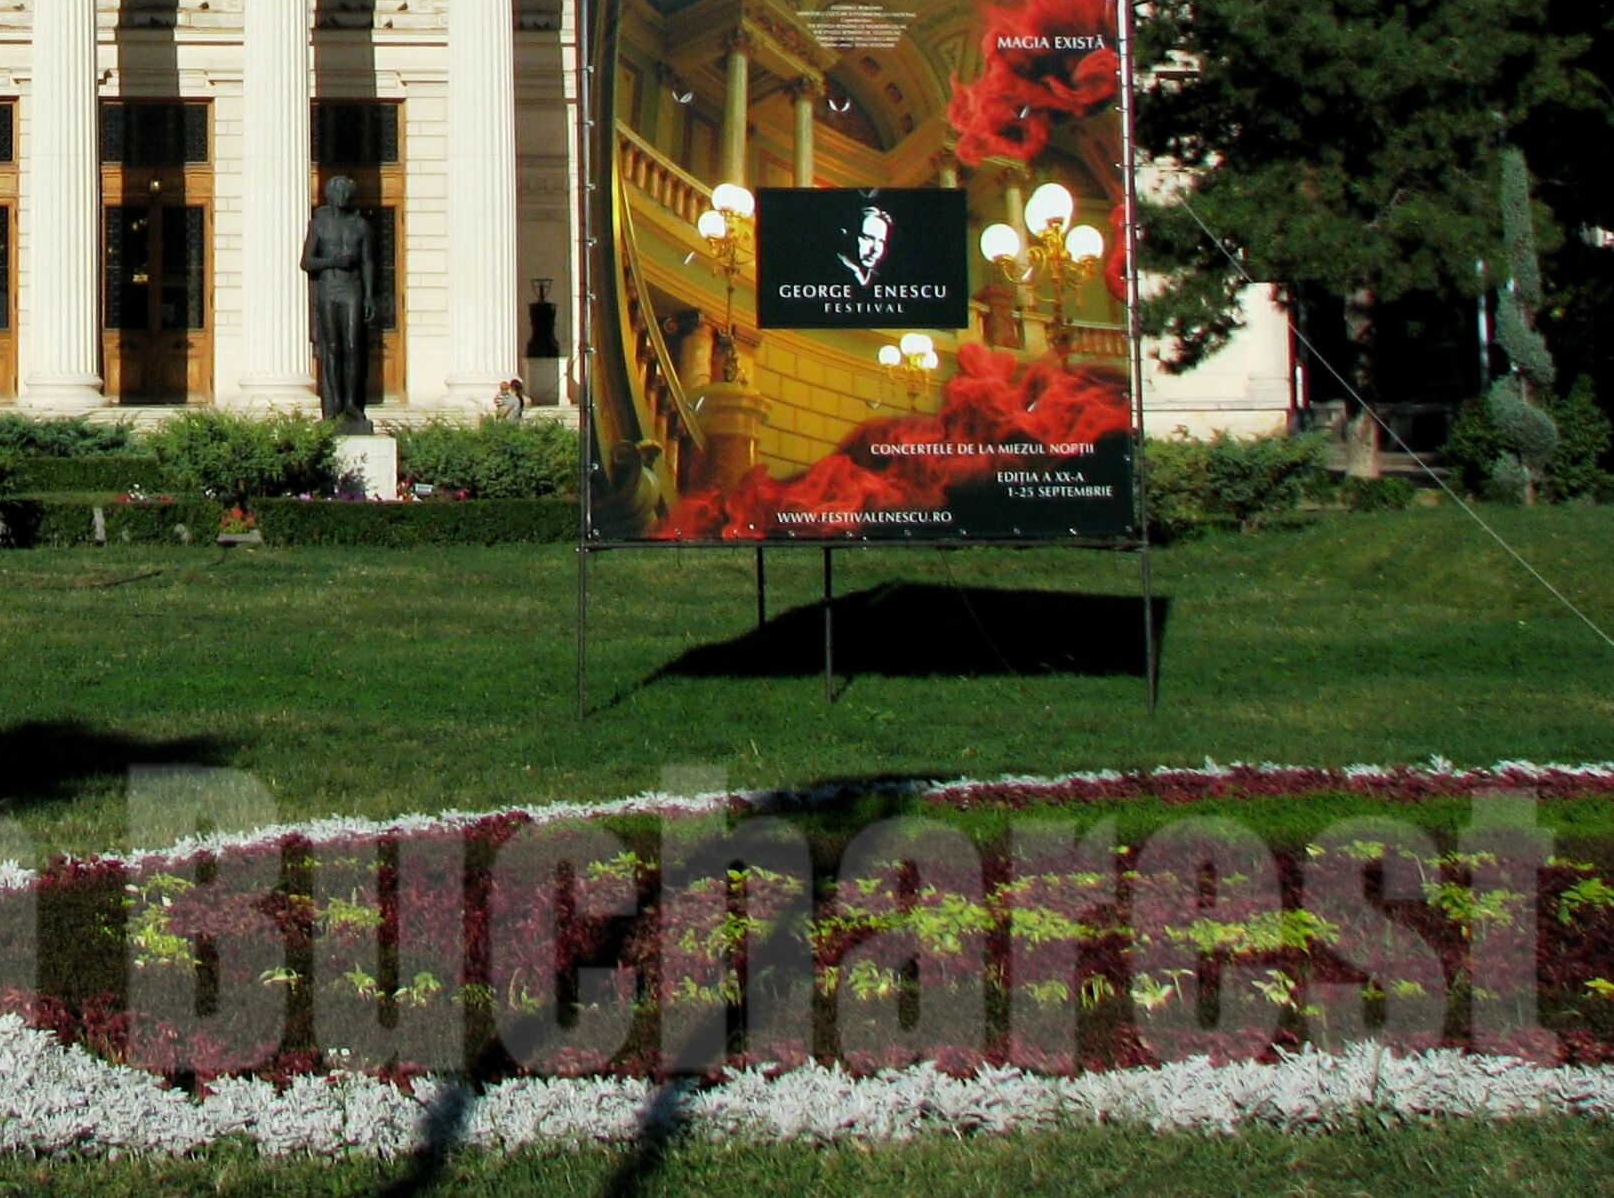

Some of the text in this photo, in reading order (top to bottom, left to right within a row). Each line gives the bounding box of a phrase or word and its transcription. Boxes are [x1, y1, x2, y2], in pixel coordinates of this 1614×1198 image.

[997, 36, 1050, 49] MAGIA
[778, 284, 947, 298] GEORGE ENESCU
[824, 303, 904, 313] FESTIVAL
[870, 443, 953, 455] CONCERTELE
[957, 444, 975, 455] DE
[978, 444, 994, 455] LA
[997, 444, 1045, 455] MIEZUL
[1042, 471, 1051, 483] A
[1055, 471, 1084, 483] XX-A
[1007, 485, 1113, 498] 1-25 SEPTEMBRIE
[777, 511, 952, 523] WWW.FESTIVALENESCU.RO
